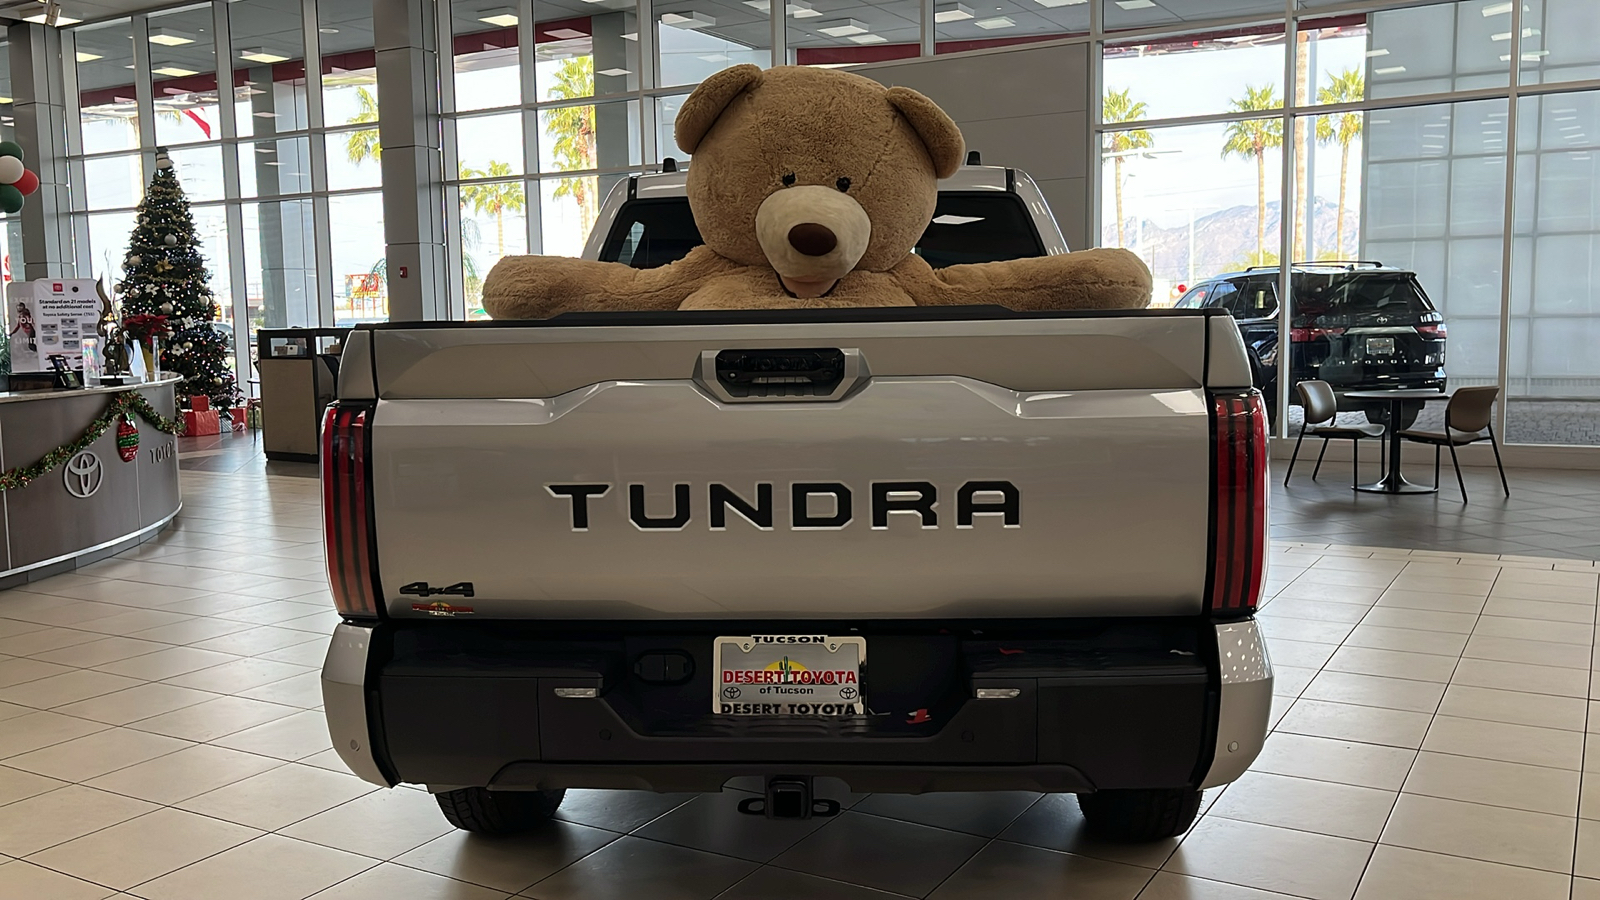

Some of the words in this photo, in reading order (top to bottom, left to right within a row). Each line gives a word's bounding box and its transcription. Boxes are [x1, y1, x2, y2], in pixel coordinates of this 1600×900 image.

[149, 440, 175, 464] TOYOT
[543, 480, 1022, 531] TUNDRA
[753, 635, 825, 643] TUCSON
[723, 670, 784, 684] DESERT
[791, 670, 857, 684] TOYOTA
[759, 686, 774, 695] of
[775, 686, 814, 695] Tucson
[721, 703, 781, 715] DESERT
[788, 703, 856, 715] TOYOTA
